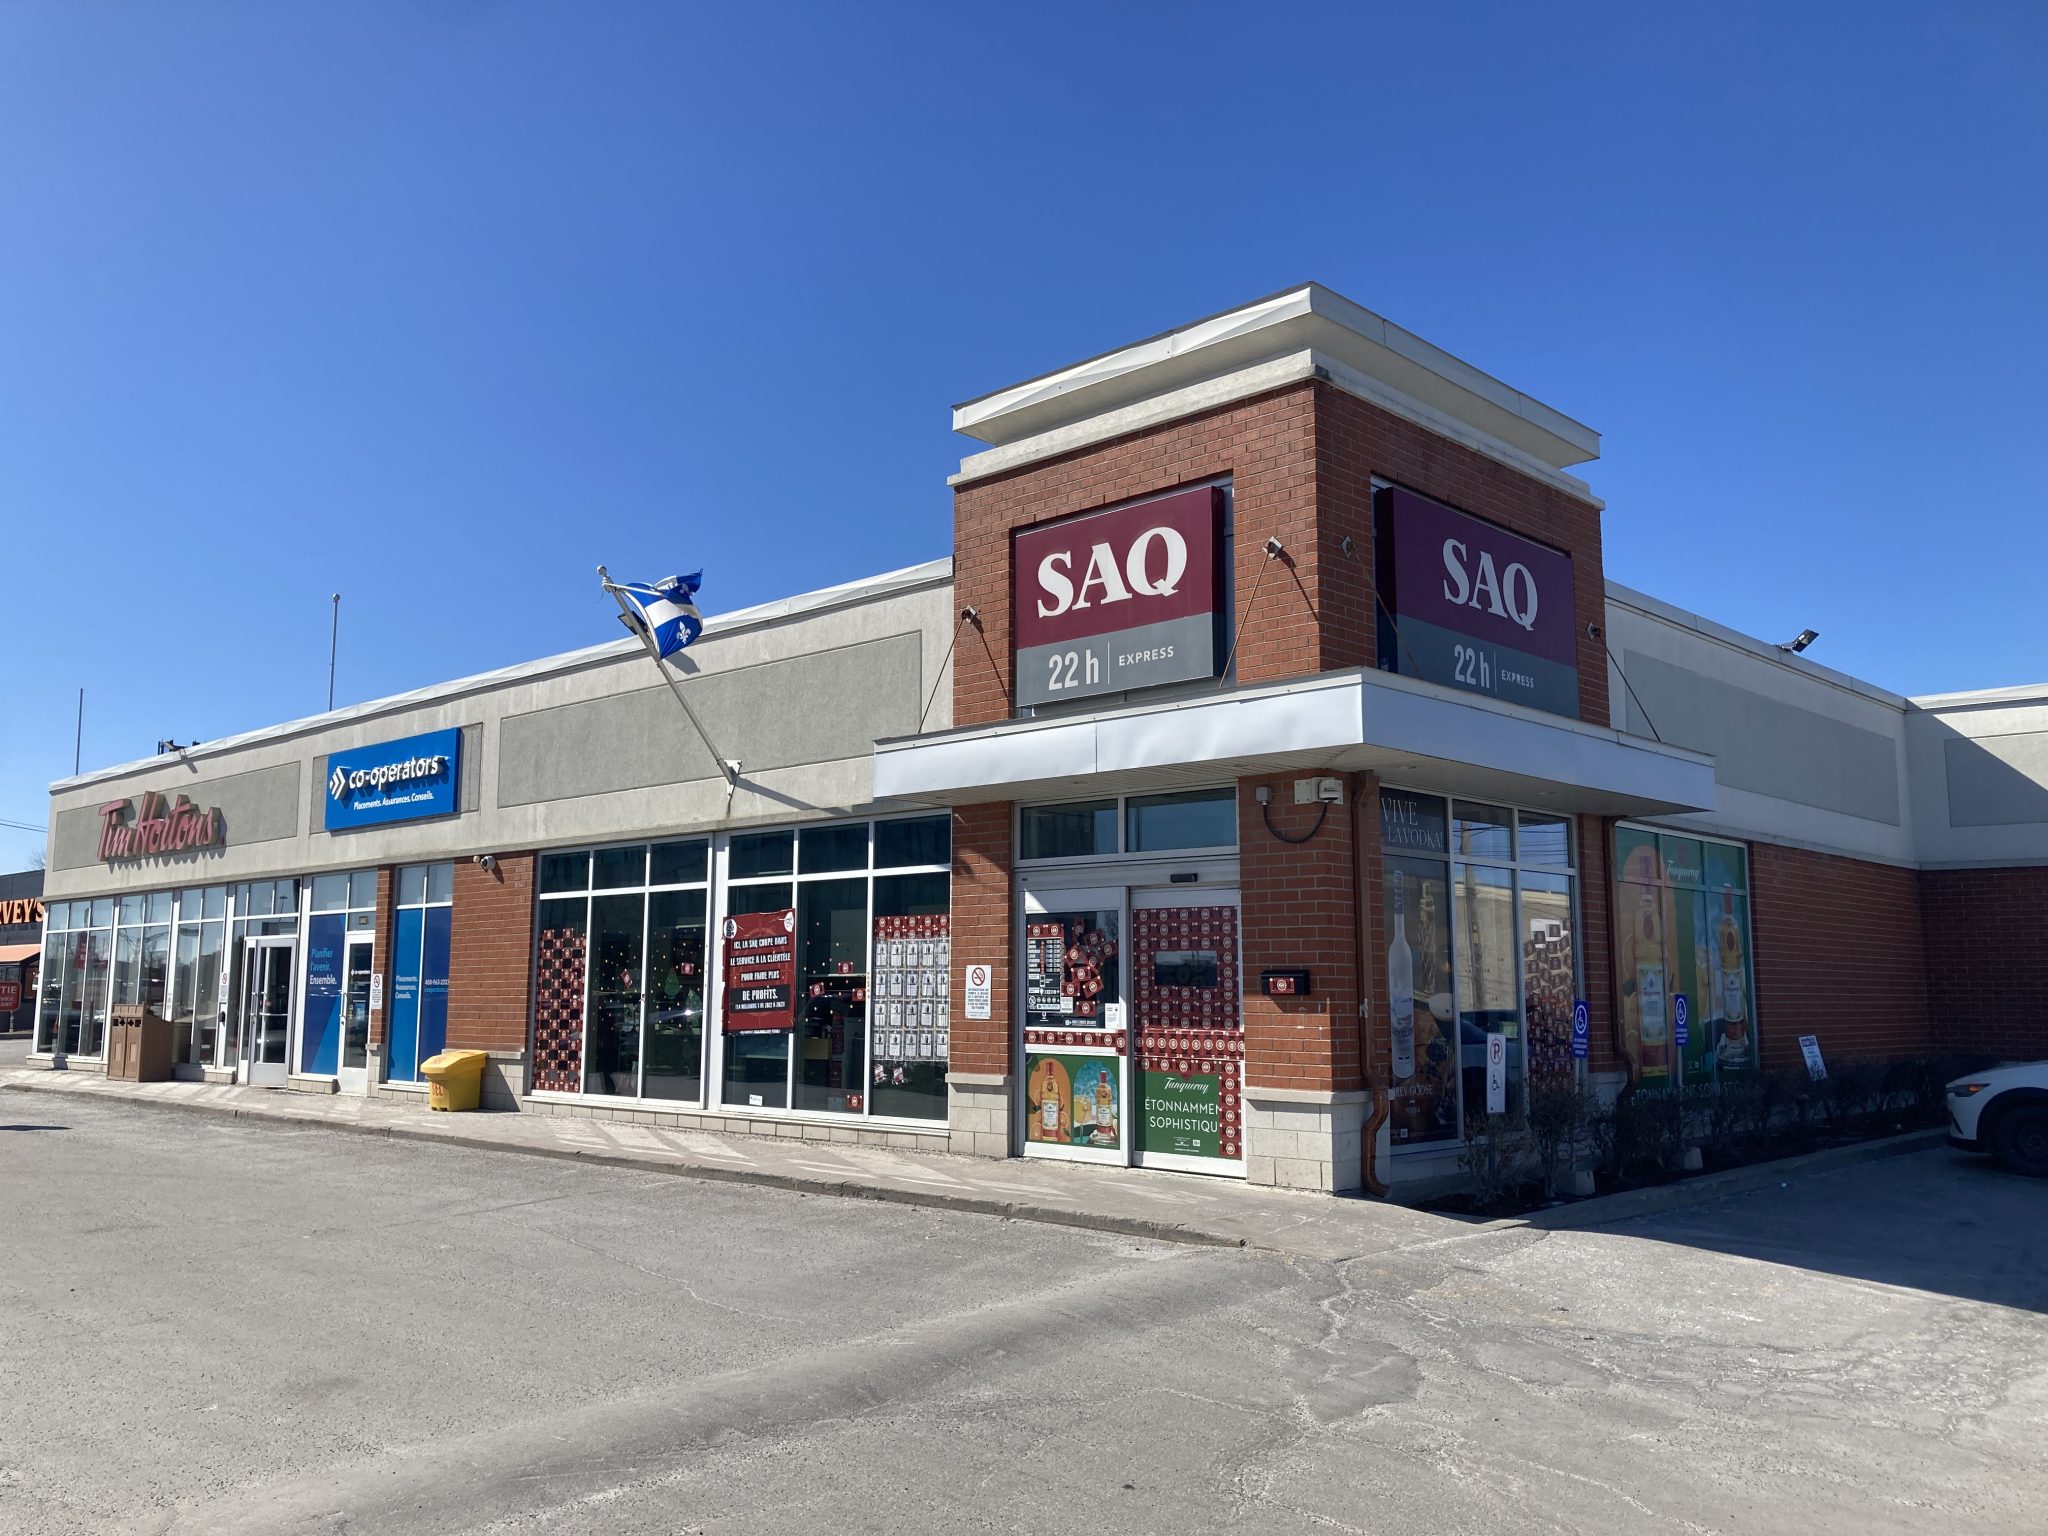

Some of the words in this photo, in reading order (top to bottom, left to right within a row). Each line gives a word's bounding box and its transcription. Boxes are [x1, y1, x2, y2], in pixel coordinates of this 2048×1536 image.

[1037, 526, 1188, 619] SAQ
[1442, 538, 1538, 632] SAQ
[1118, 646, 1174, 667] EXPRESS
[1454, 644, 1477, 686] 22
[1479, 651, 1490, 689] h
[1048, 651, 1079, 691] 22
[1085, 649, 1099, 685] h
[1501, 669, 1534, 689] EXPRESS
[348, 755, 441, 791] co-operators
[411, 790, 434, 802] Conseils.
[1381, 797, 1418, 826] VIVE
[97, 799, 132, 861] Tim
[133, 791, 217, 857] Hortons
[0, 898, 44, 925] VEY'S
[742, 940, 749, 949] LA
[749, 939, 758, 948] SAQ
[758, 937, 774, 947] COUPE
[730, 957, 736, 966] LE
[736, 955, 755, 966] SERVICE
[760, 954, 767, 964] LA
[309, 974, 337, 985] Ensemble.
[740, 972, 754, 982] POUR
[754, 971, 768, 981] FAIRE
[768, 970, 780, 979] PLUS
[742, 990, 751, 1001] DE
[751, 988, 779, 1001] PROFITS.
[1164, 1077, 1209, 1094] Tanqueray
